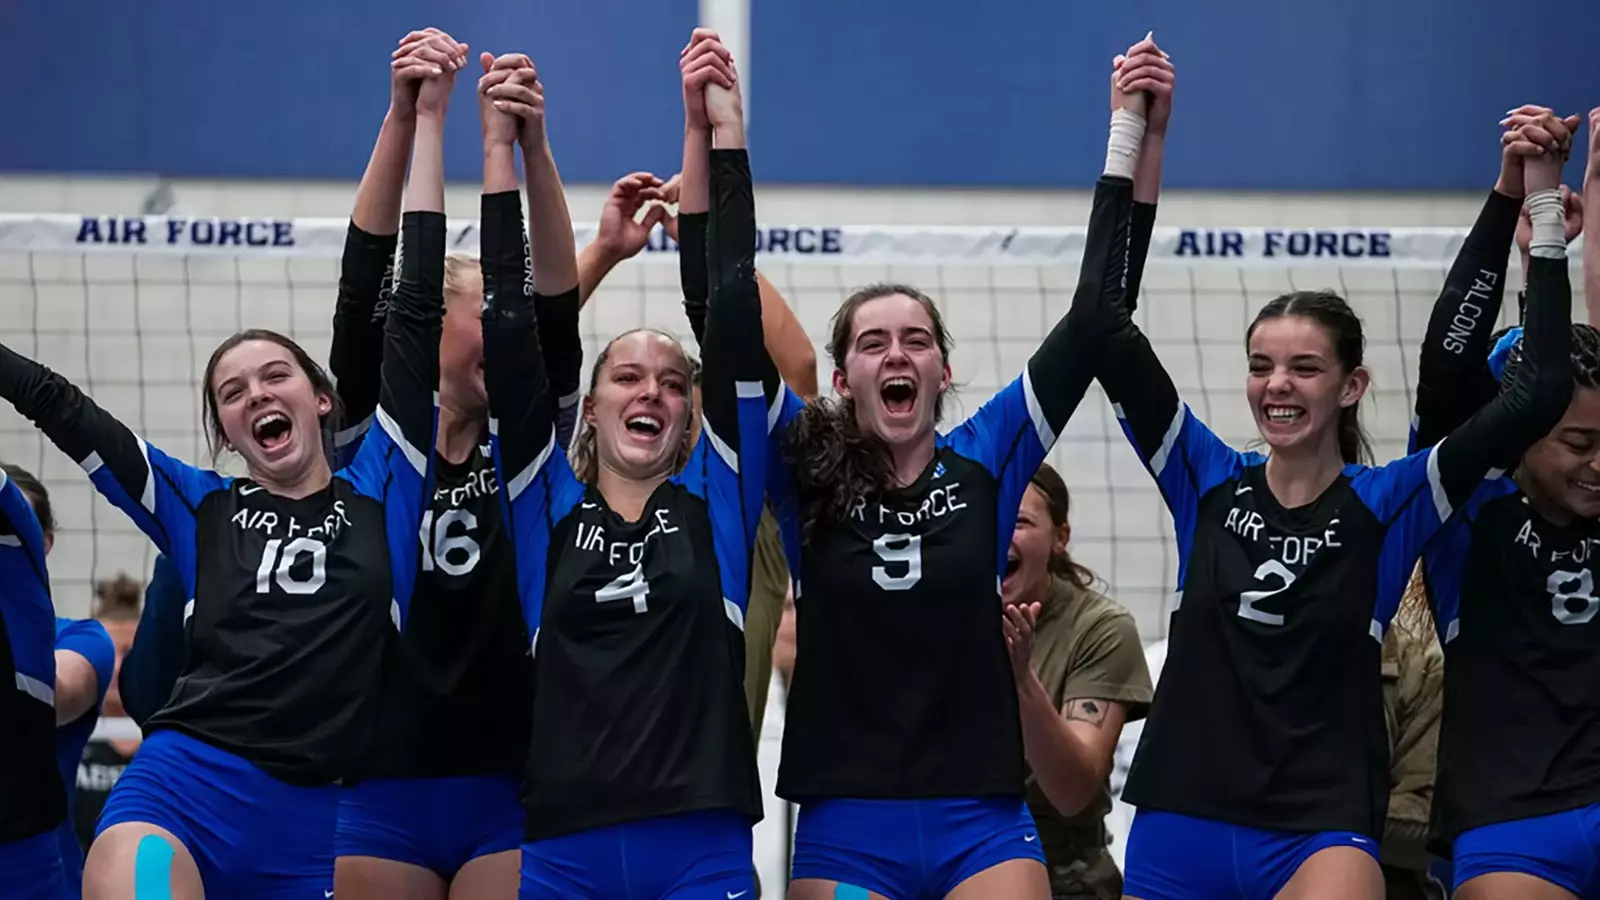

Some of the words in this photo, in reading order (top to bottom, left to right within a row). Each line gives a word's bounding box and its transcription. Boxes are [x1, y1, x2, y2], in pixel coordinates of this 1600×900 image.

[76, 218, 147, 244] AIR
[167, 219, 295, 247] FORCE
[1175, 230, 1244, 257] AIR
[1263, 231, 1392, 258] FORCE
[1442, 268, 1498, 355] FALCONS
[231, 507, 279, 536] AIR
[418, 507, 481, 577] 16
[1224, 507, 1266, 542] AIR
[255, 537, 327, 595] 10
[594, 562, 651, 614] 4
[871, 533, 923, 591] 9
[1237, 558, 1297, 626] 2
[1546, 567, 1600, 625] 8
